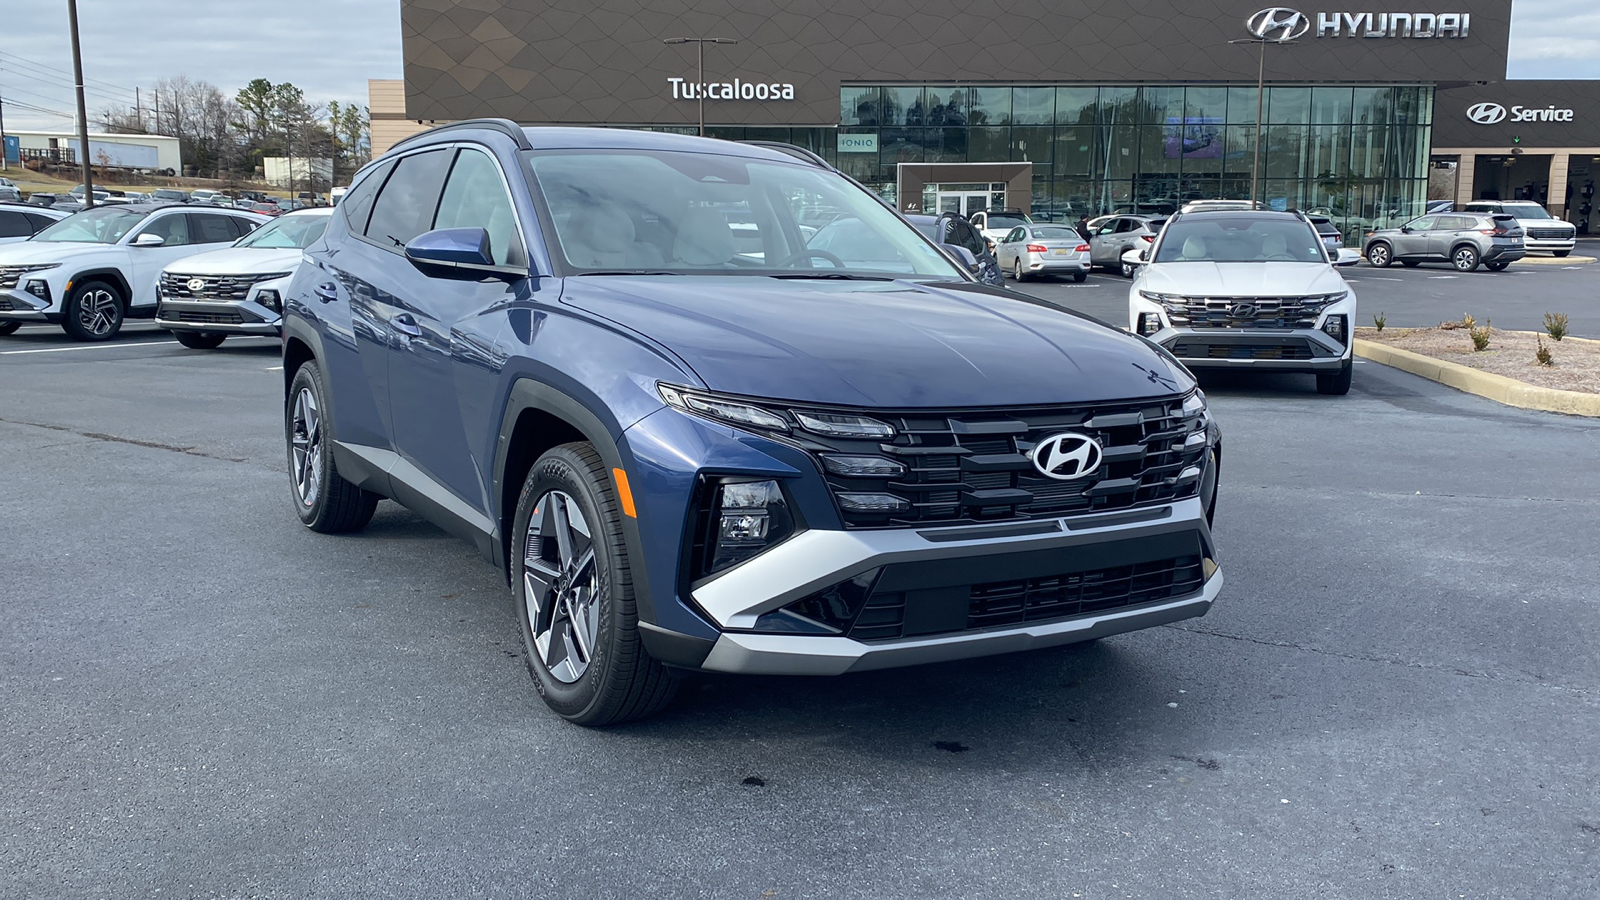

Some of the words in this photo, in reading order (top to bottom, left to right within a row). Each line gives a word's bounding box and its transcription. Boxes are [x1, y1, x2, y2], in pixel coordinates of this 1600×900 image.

[1316, 12, 1470, 38] HYUNDAI
[667, 77, 794, 99] Tuscaloosa
[1510, 104, 1574, 122] Service
